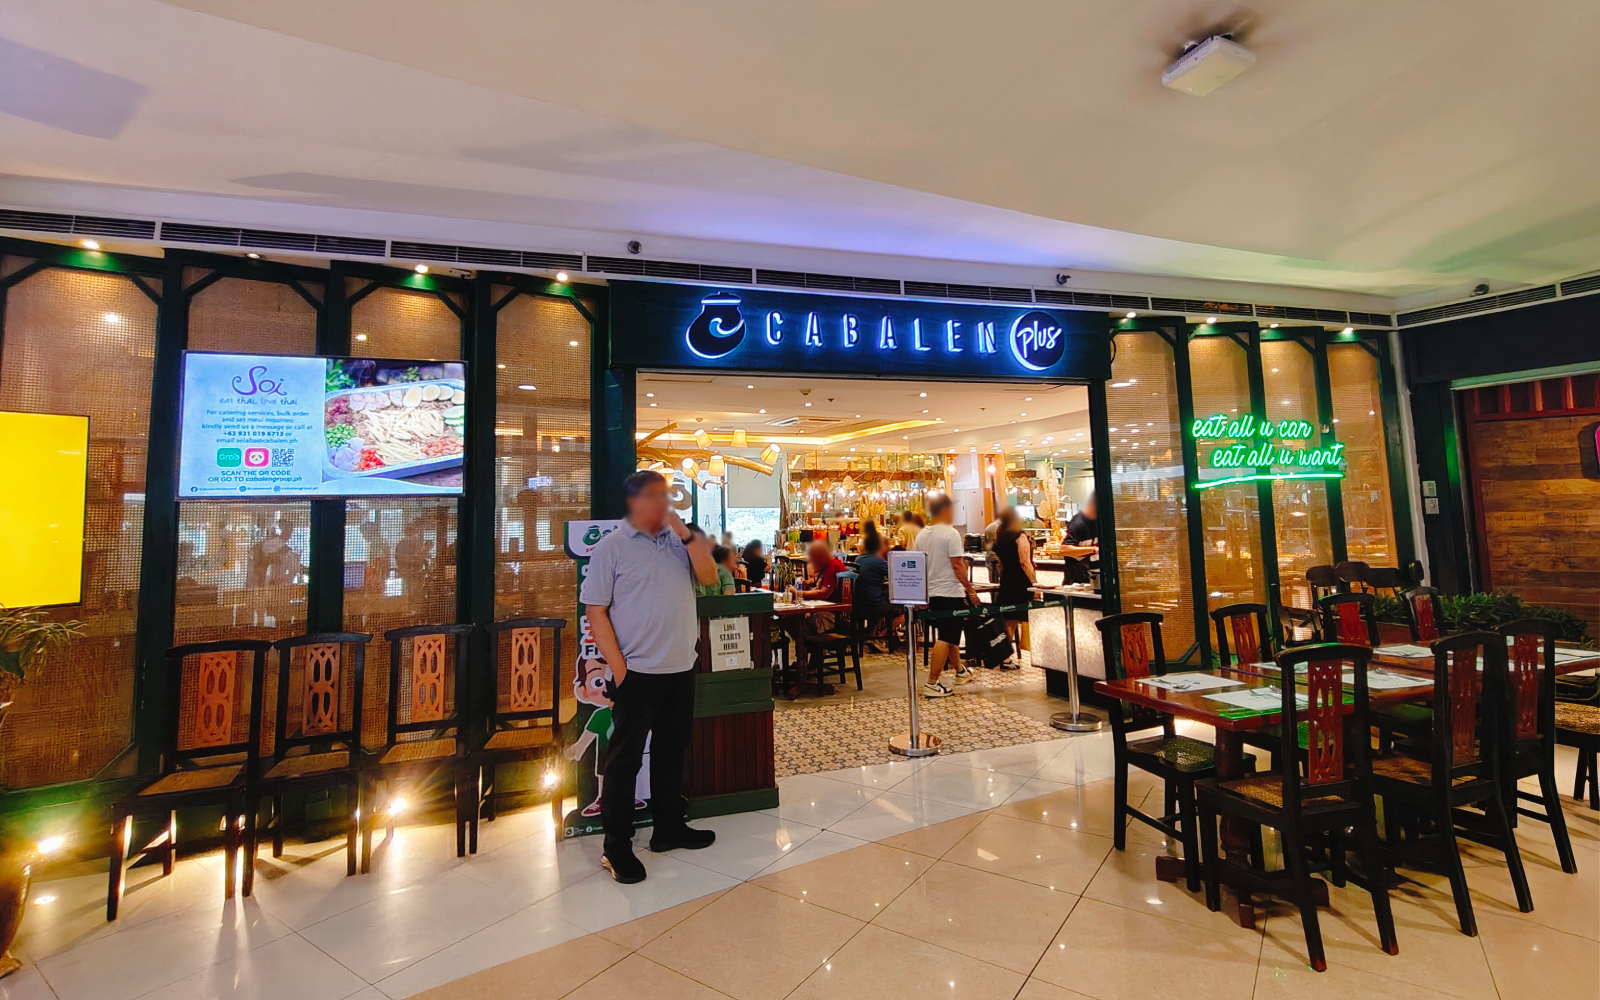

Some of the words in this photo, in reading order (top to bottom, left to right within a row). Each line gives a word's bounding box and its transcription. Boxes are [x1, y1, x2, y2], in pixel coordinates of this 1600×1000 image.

[766, 310, 997, 354] CABALEN
[1016, 321, 1063, 358] plus
[231, 365, 288, 396] Soi
[260, 397, 277, 405] love
[280, 396, 297, 406] thai
[1192, 414, 1228, 438] eat
[1227, 414, 1256, 438] all
[1260, 422, 1275, 437] u
[1279, 420, 1312, 438] can
[218, 453, 240, 461] Grab
[1213, 444, 1246, 467] eat
[1246, 442, 1275, 467] all
[1279, 449, 1294, 465] u
[1299, 444, 1344, 466] want
[245, 476, 302, 484] cabalengroup.ph
[723, 623, 736, 631] LINE
[719, 632, 741, 641] STARTS
[723, 642, 738, 651] HERE
